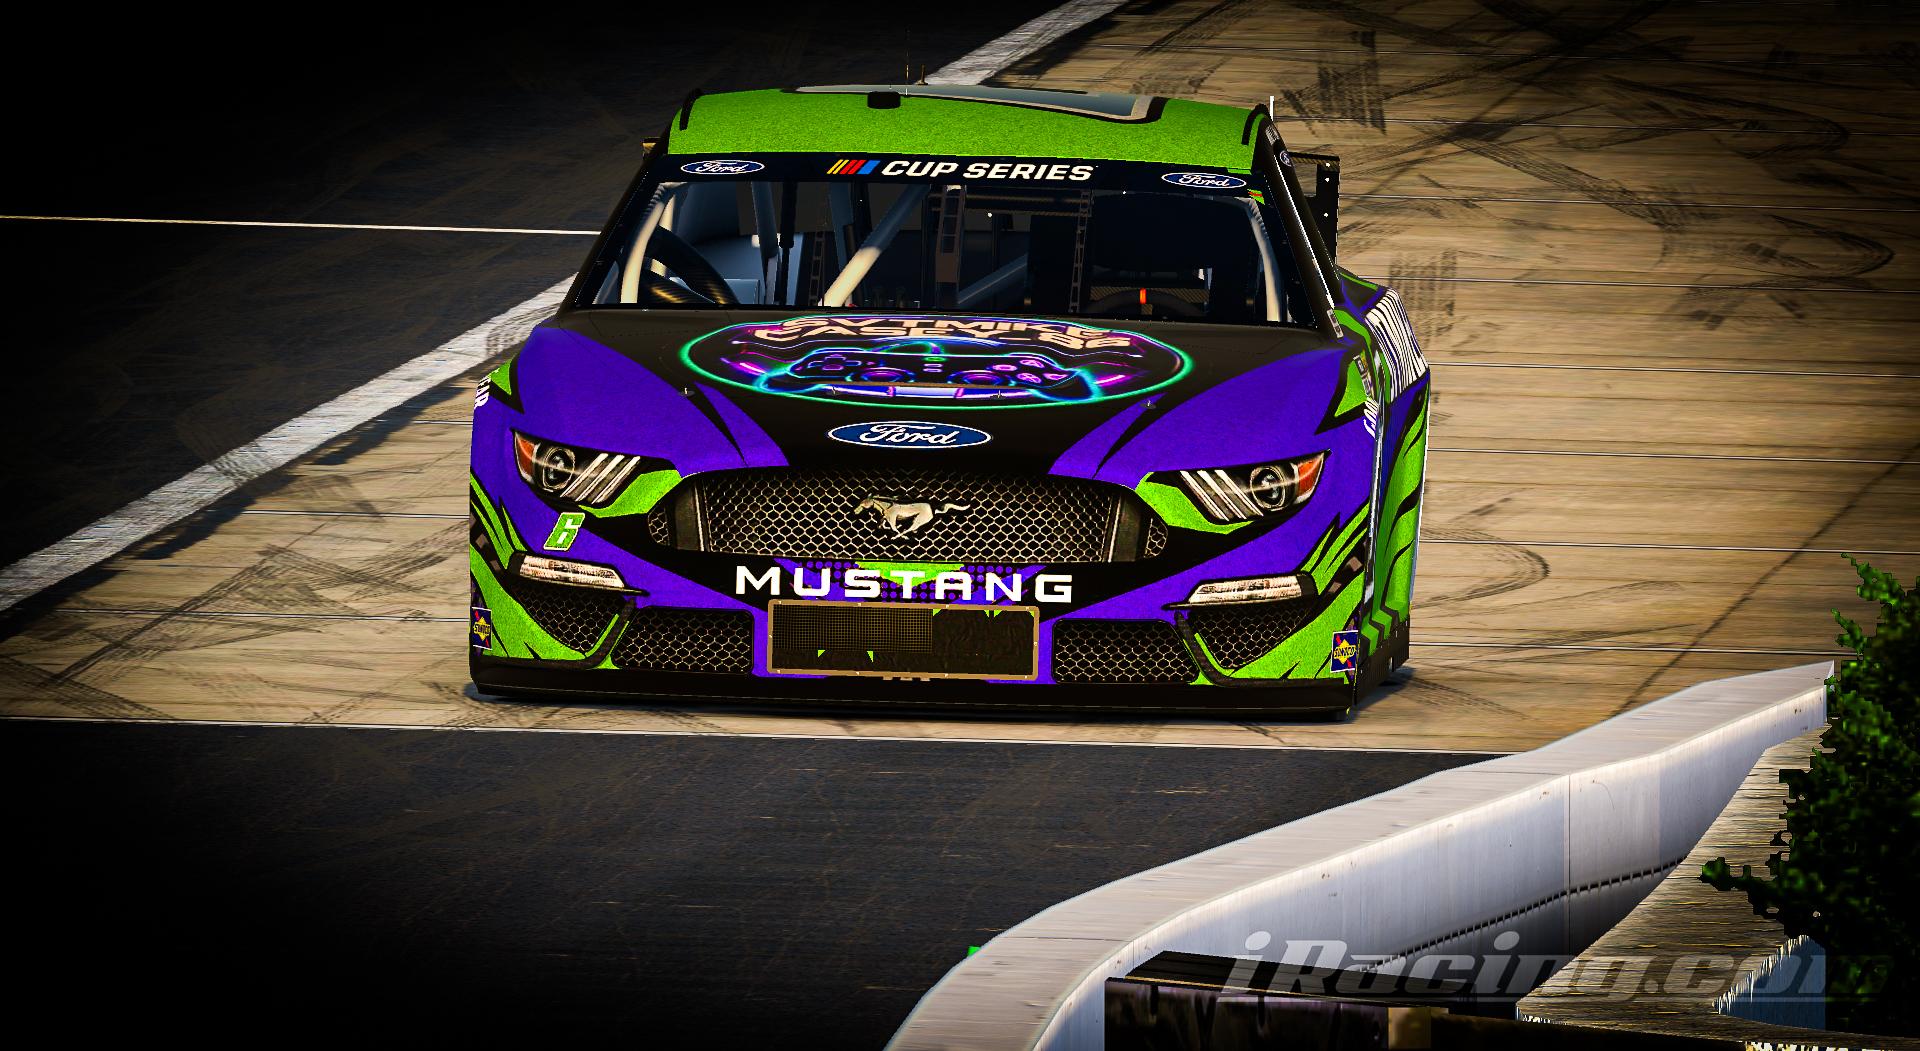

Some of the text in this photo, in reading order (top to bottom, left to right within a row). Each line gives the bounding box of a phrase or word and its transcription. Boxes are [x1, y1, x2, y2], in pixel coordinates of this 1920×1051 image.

[694, 160, 750, 174] Ford
[881, 160, 1094, 181] CUP SERIES
[1178, 173, 1232, 187] Ford
[858, 423, 960, 445] Ford
[543, 511, 586, 551] 6
[735, 565, 1073, 604] MUSTANG
